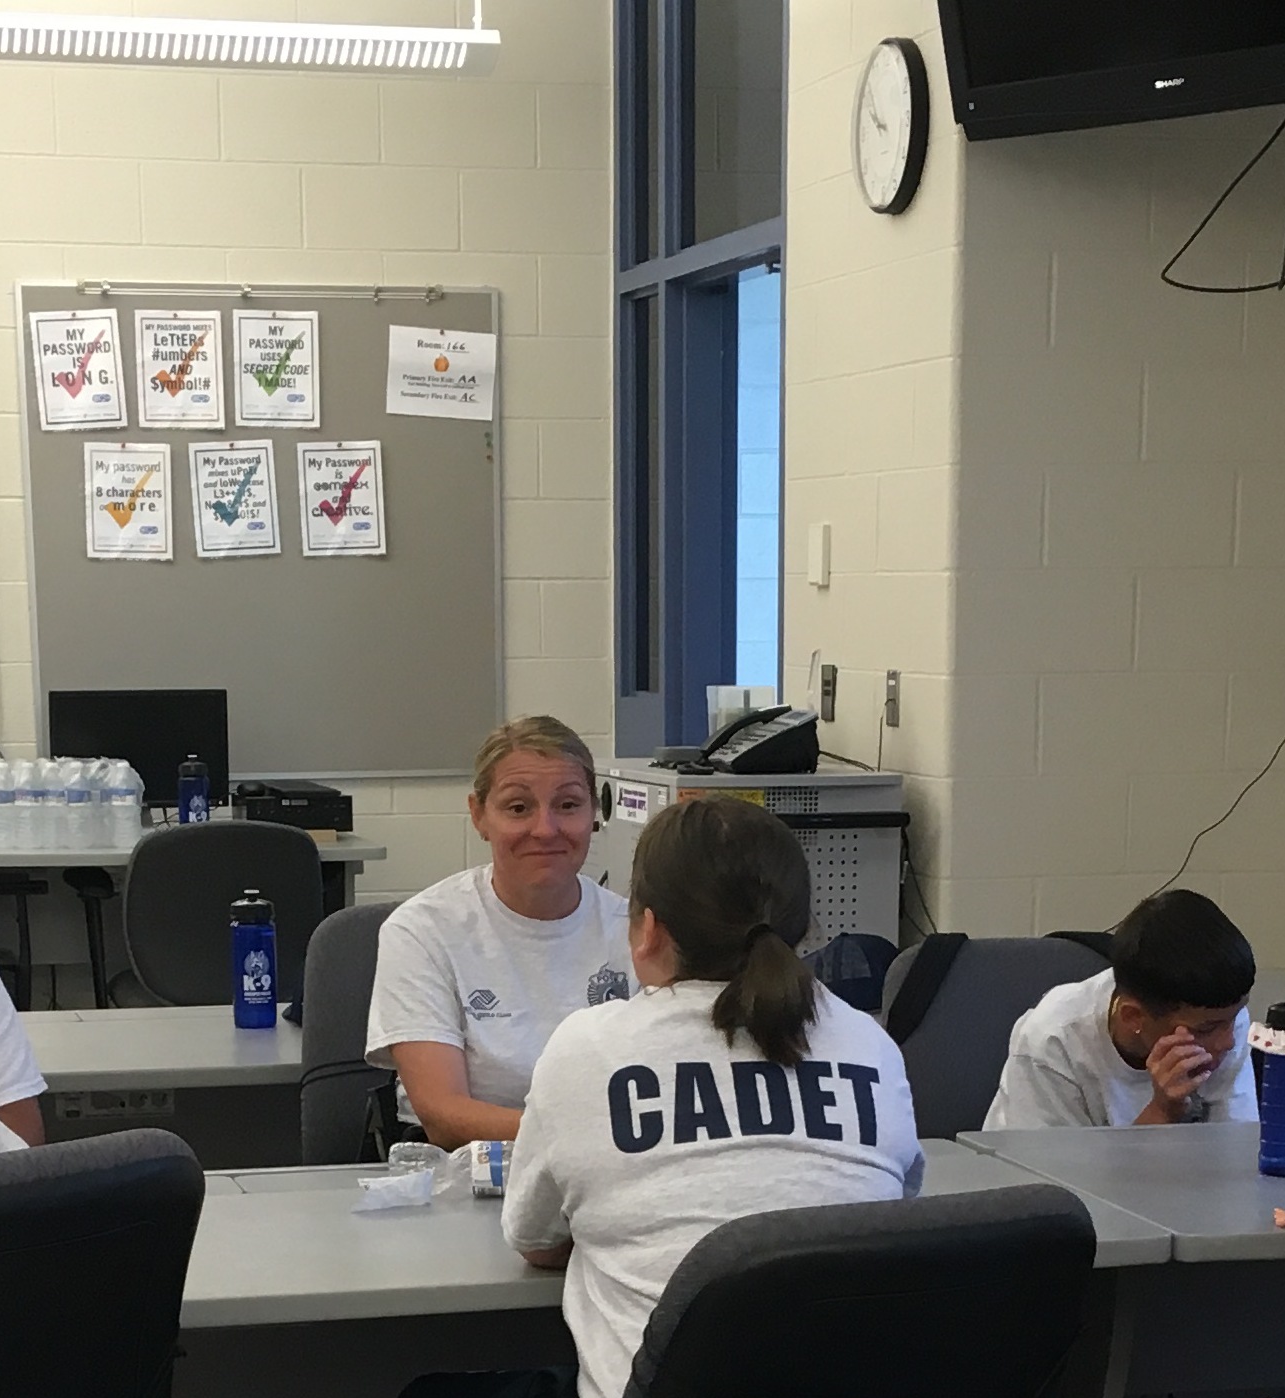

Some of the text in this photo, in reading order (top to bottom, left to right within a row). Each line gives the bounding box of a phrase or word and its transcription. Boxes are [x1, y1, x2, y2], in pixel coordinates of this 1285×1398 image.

[1154, 77, 1185, 89] SHARP
[145, 323, 155, 331] MY
[156, 323, 191, 331] PASSWORD
[268, 325, 285, 336] MY
[66, 328, 85, 341] MY
[43, 341, 111, 356] PASSWORD
[248, 338, 304, 350] PASSWORD
[417, 339, 466, 351] Room: 166
[151, 348, 208, 361] #umbers
[260, 352, 283, 361] USES
[72, 356, 85, 369] IS
[169, 364, 194, 375] AND
[243, 363, 311, 375] SECRET CODE
[95, 461, 161, 474] My password
[203, 455, 262, 468] My Password
[308, 456, 372, 470] My Password
[121, 475, 136, 484] has
[335, 469, 343, 479] is
[95, 486, 163, 498] 8 characters
[243, 974, 272, 991] K-9
[607, 1060, 880, 1154] CADET
